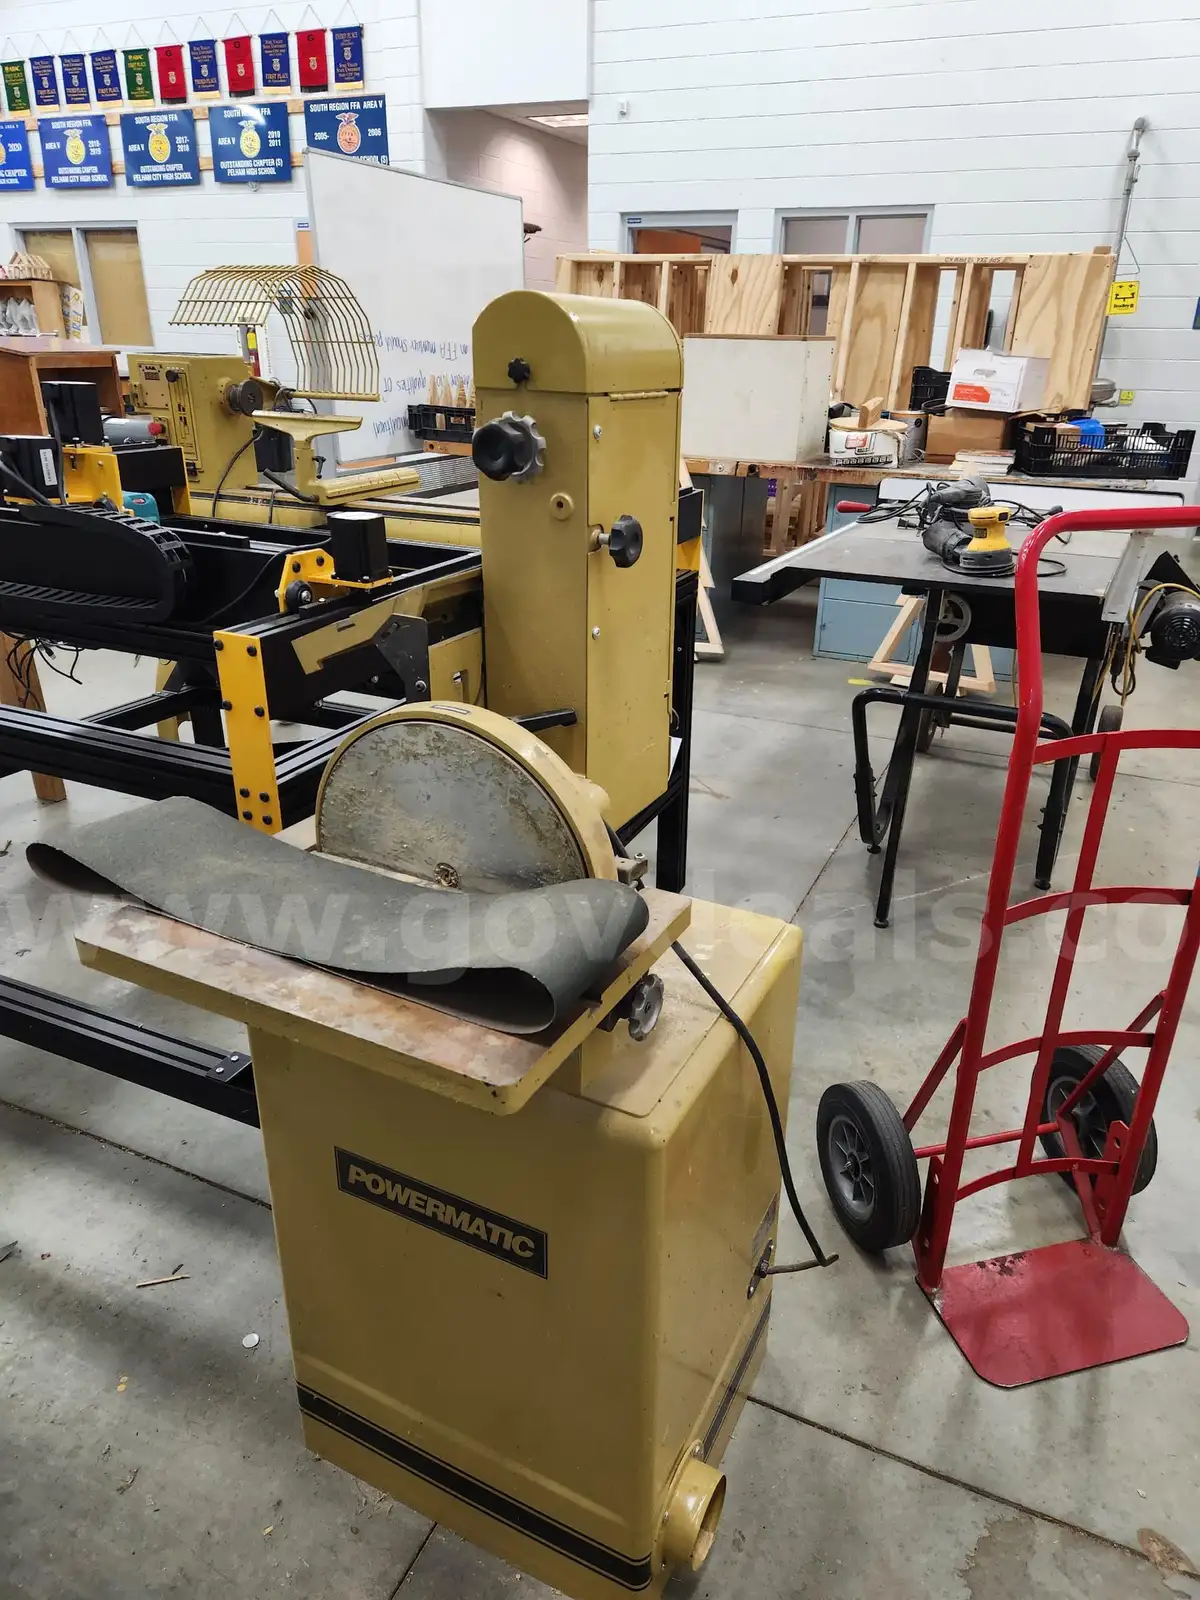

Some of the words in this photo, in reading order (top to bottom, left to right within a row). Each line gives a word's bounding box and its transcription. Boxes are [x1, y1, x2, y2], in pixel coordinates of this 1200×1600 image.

[310, 104, 328, 112] SOUTH
[329, 102, 349, 111] REGION
[350, 101, 361, 110] FFA
[363, 100, 378, 109] AREA
[224, 110, 240, 118] SOUTH
[134, 115, 150, 124] SOUTH
[151, 115, 168, 123] REGION
[314, 132, 330, 140] 2005-
[368, 128, 381, 136] 2006
[269, 139, 281, 147] 2011
[220, 160, 252, 169] OUTSTANDING
[253, 159, 275, 167] CHAPTER
[133, 173, 152, 181] PELHAM
[174, 172, 192, 180] SCHOOL
[440, 343, 457, 361] FFA
[348, 1164, 535, 1258] POWERMATIC
